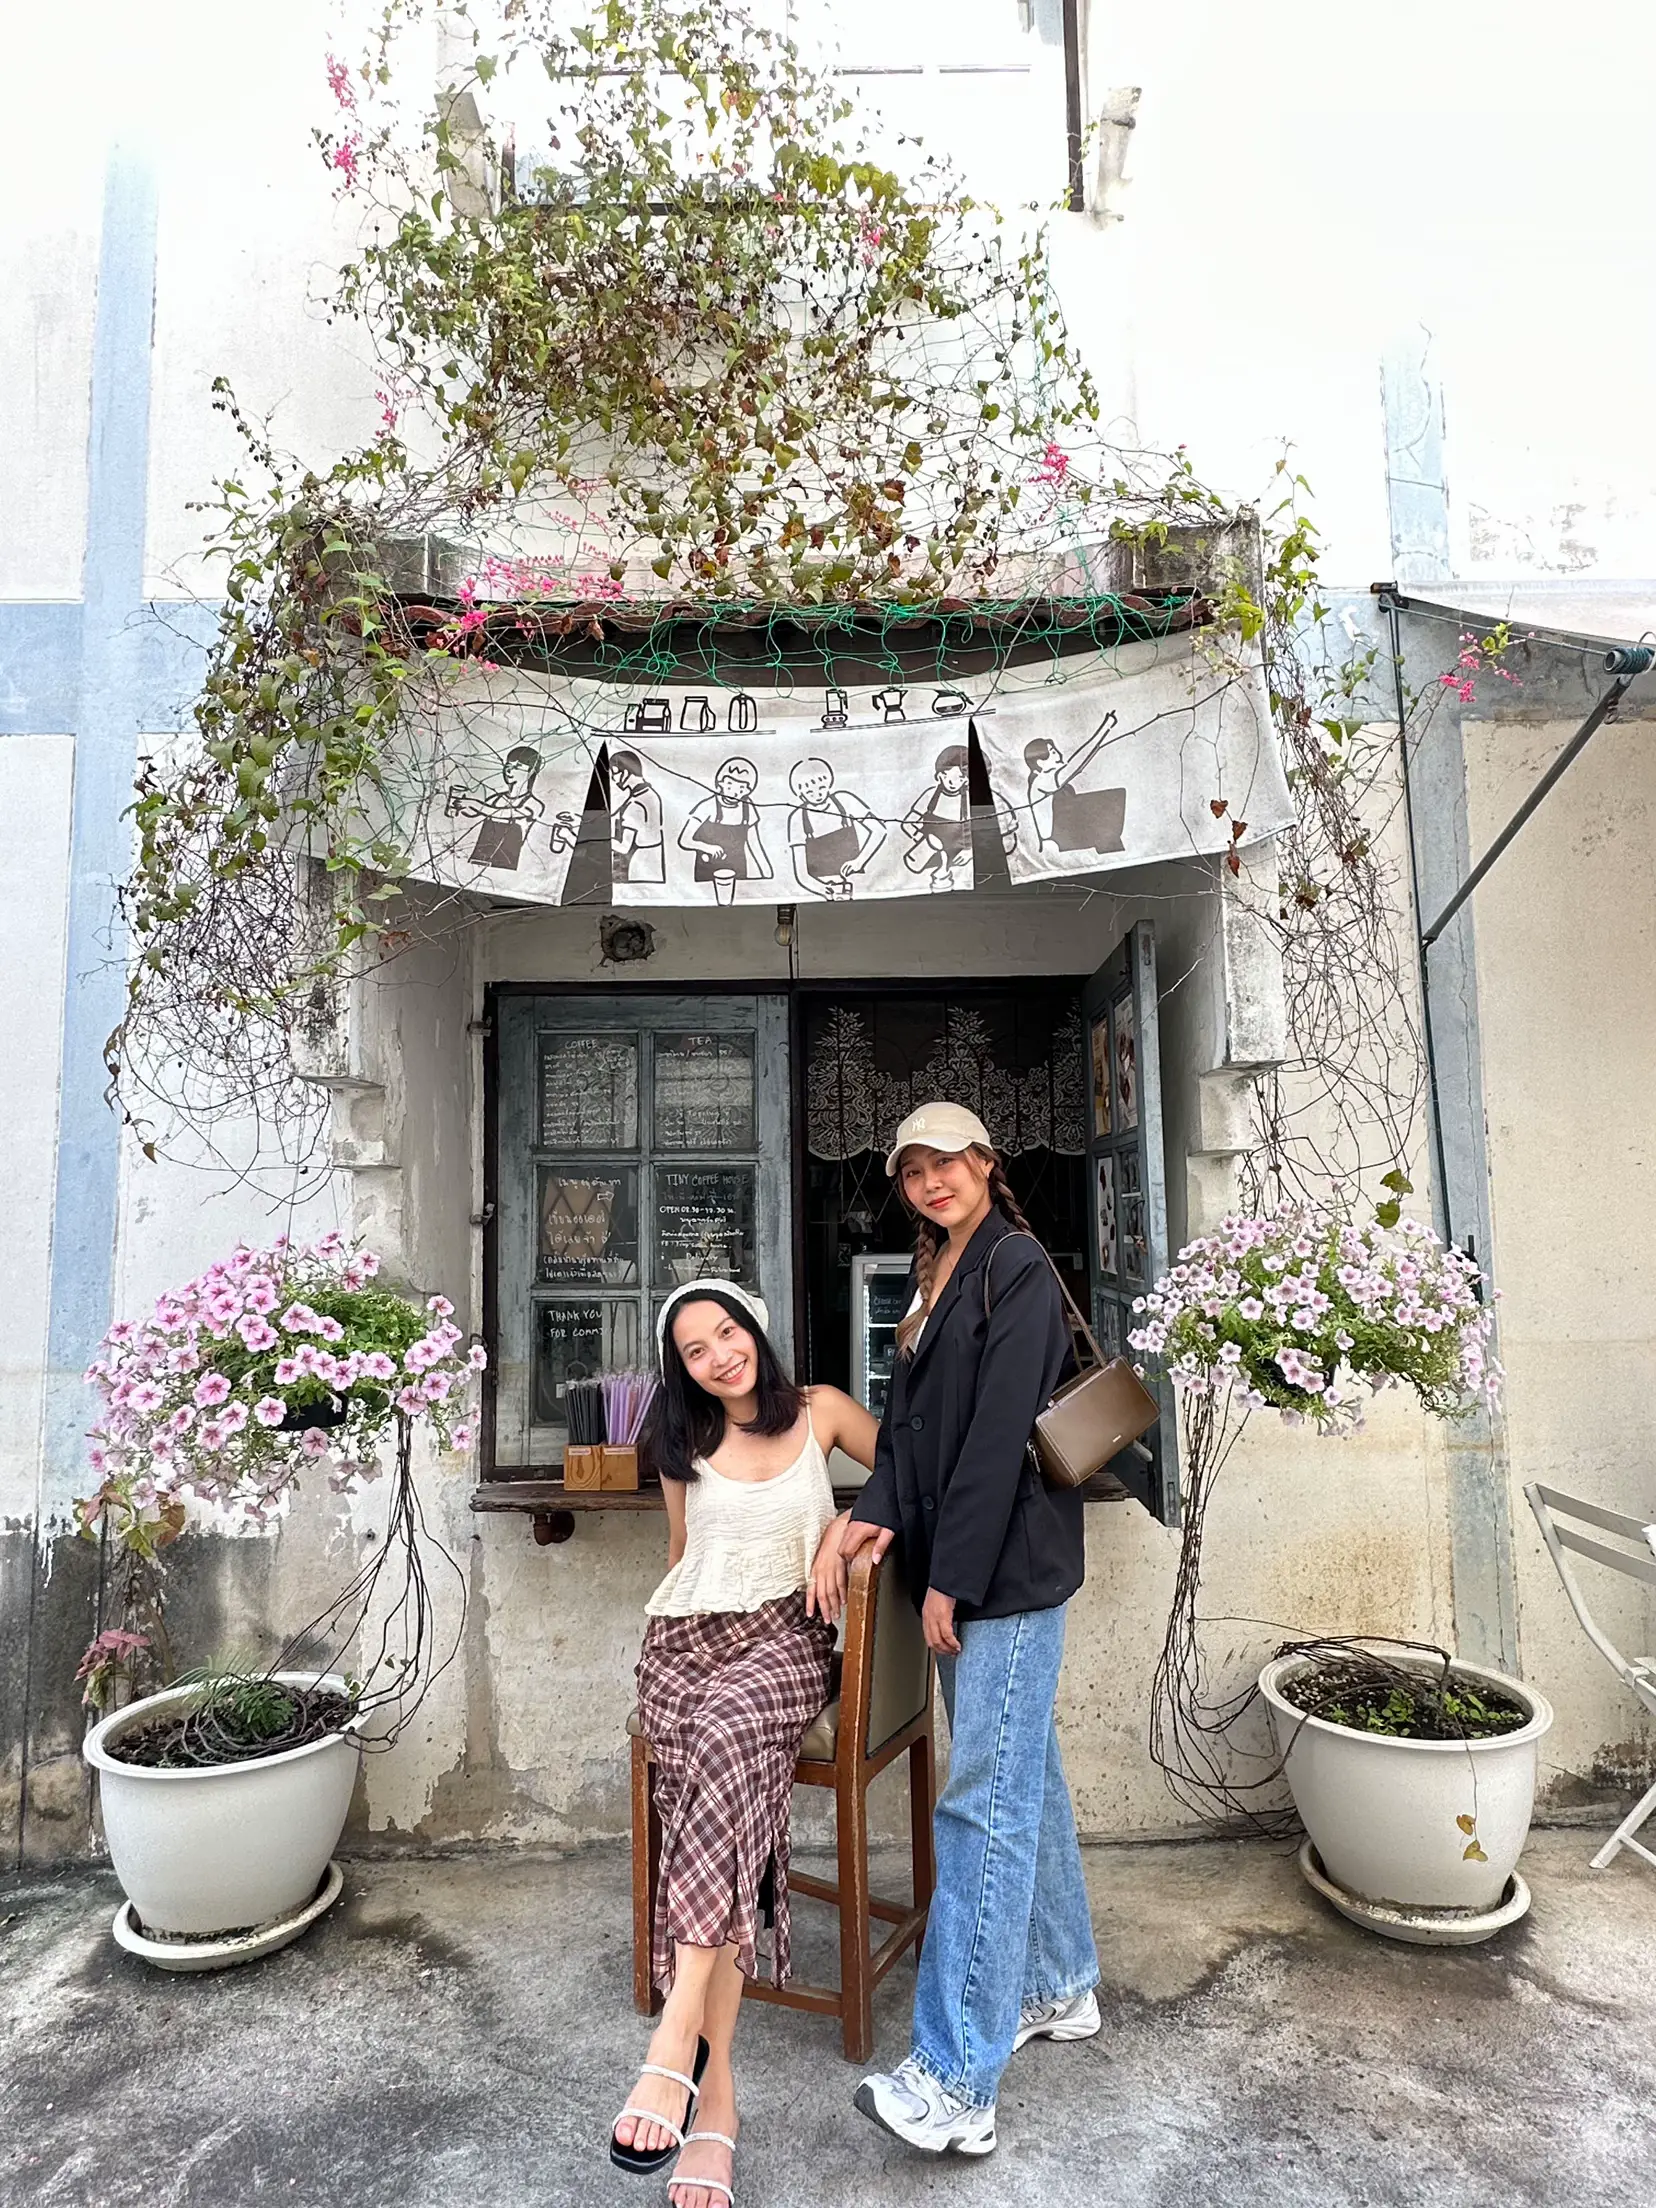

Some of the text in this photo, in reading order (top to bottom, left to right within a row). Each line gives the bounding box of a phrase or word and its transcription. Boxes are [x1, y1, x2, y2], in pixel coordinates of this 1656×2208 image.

[565, 1040, 598, 1050] COFFEE
[688, 1036, 713, 1046] TEA
[665, 1172, 749, 1187] TINY COFFEE HOUSE
[659, 1205, 680, 1214] OPEN
[548, 1309, 603, 1322] THANK YOU
[550, 1327, 567, 1338] FOR
